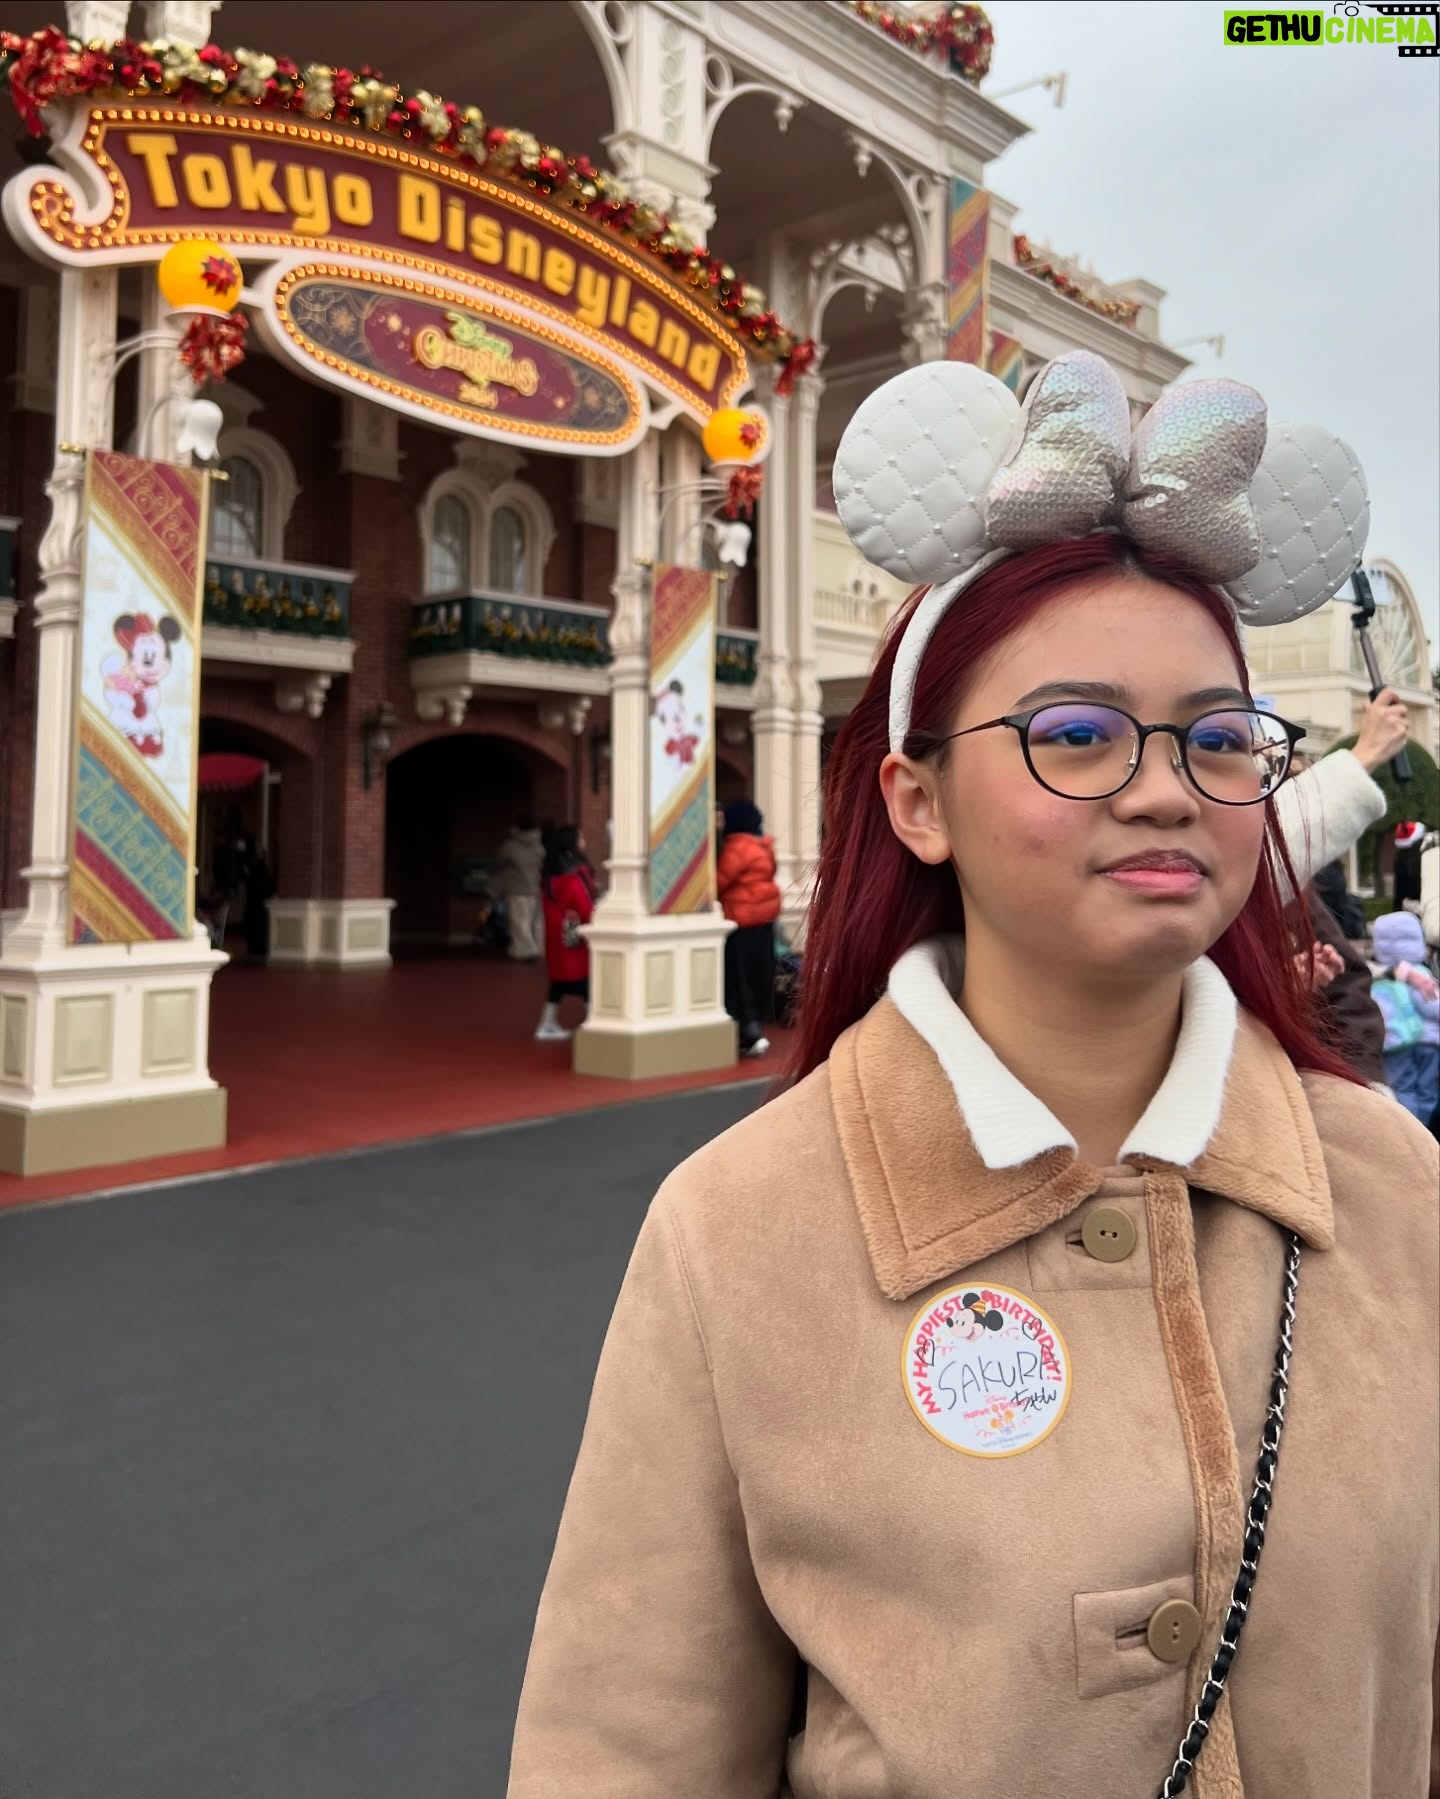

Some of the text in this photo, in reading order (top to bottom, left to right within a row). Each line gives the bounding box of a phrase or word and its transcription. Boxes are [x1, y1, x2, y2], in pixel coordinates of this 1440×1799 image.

[126, 134, 722, 392] Tokyo Disneyland
[912, 1295, 962, 1378] HAPPIEST
[915, 1381, 941, 1414] MY
